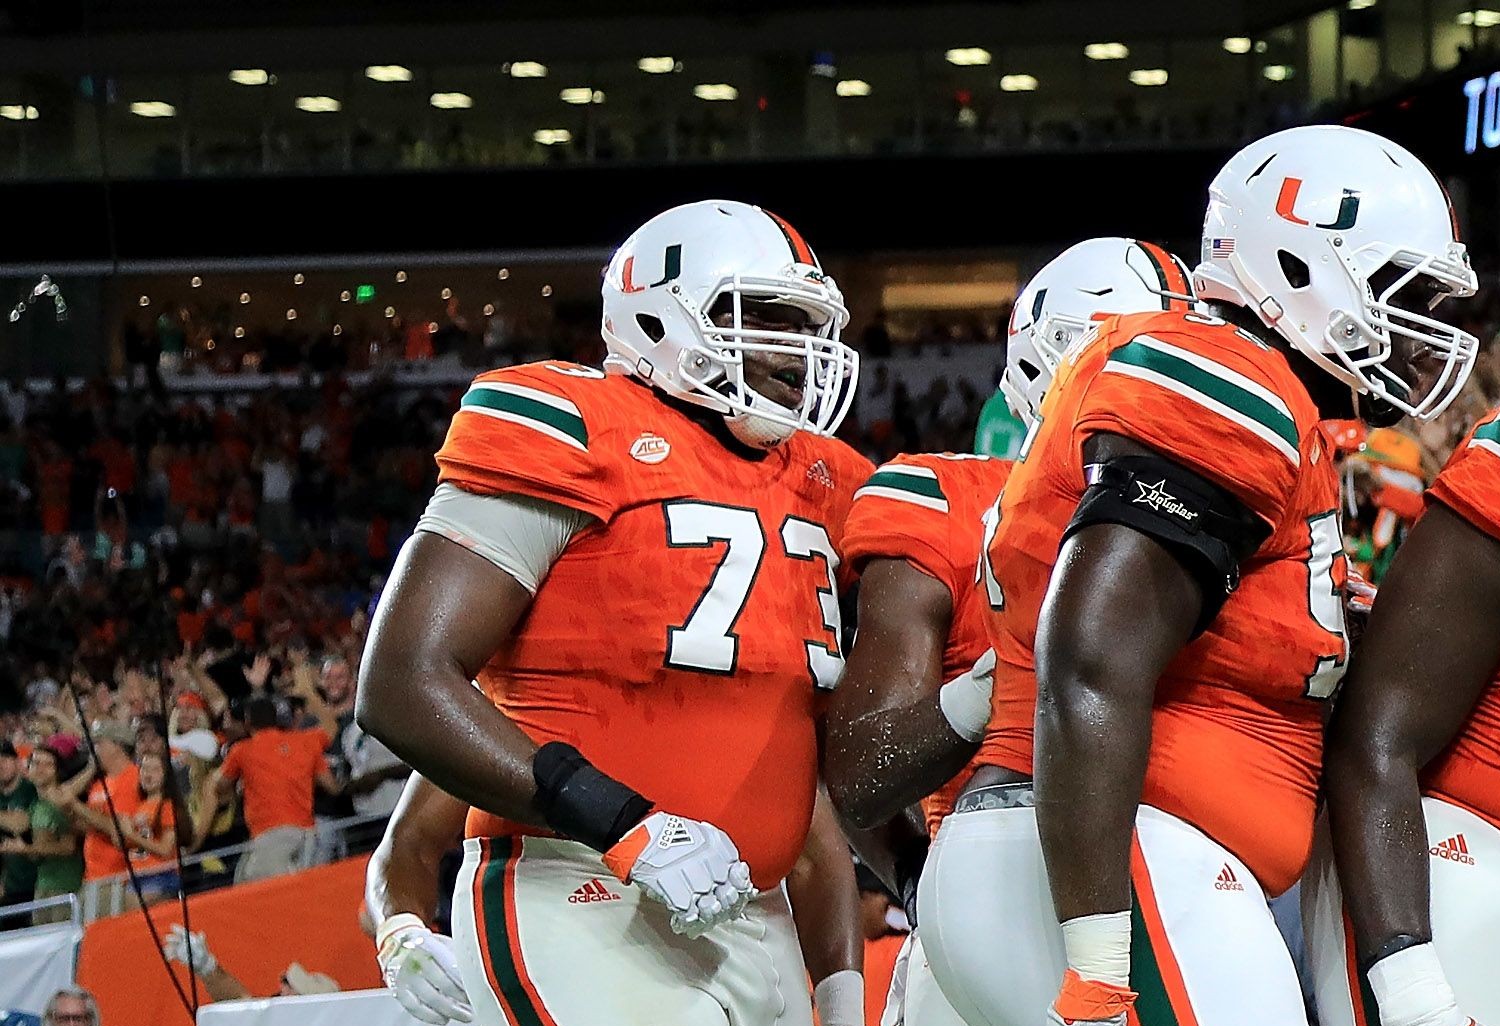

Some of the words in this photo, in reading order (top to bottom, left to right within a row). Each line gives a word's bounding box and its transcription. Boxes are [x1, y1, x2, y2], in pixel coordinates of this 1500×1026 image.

[1147, 490, 1194, 520] Douglas
[663, 499, 846, 692] 73
[1429, 847, 1475, 866] adidas
